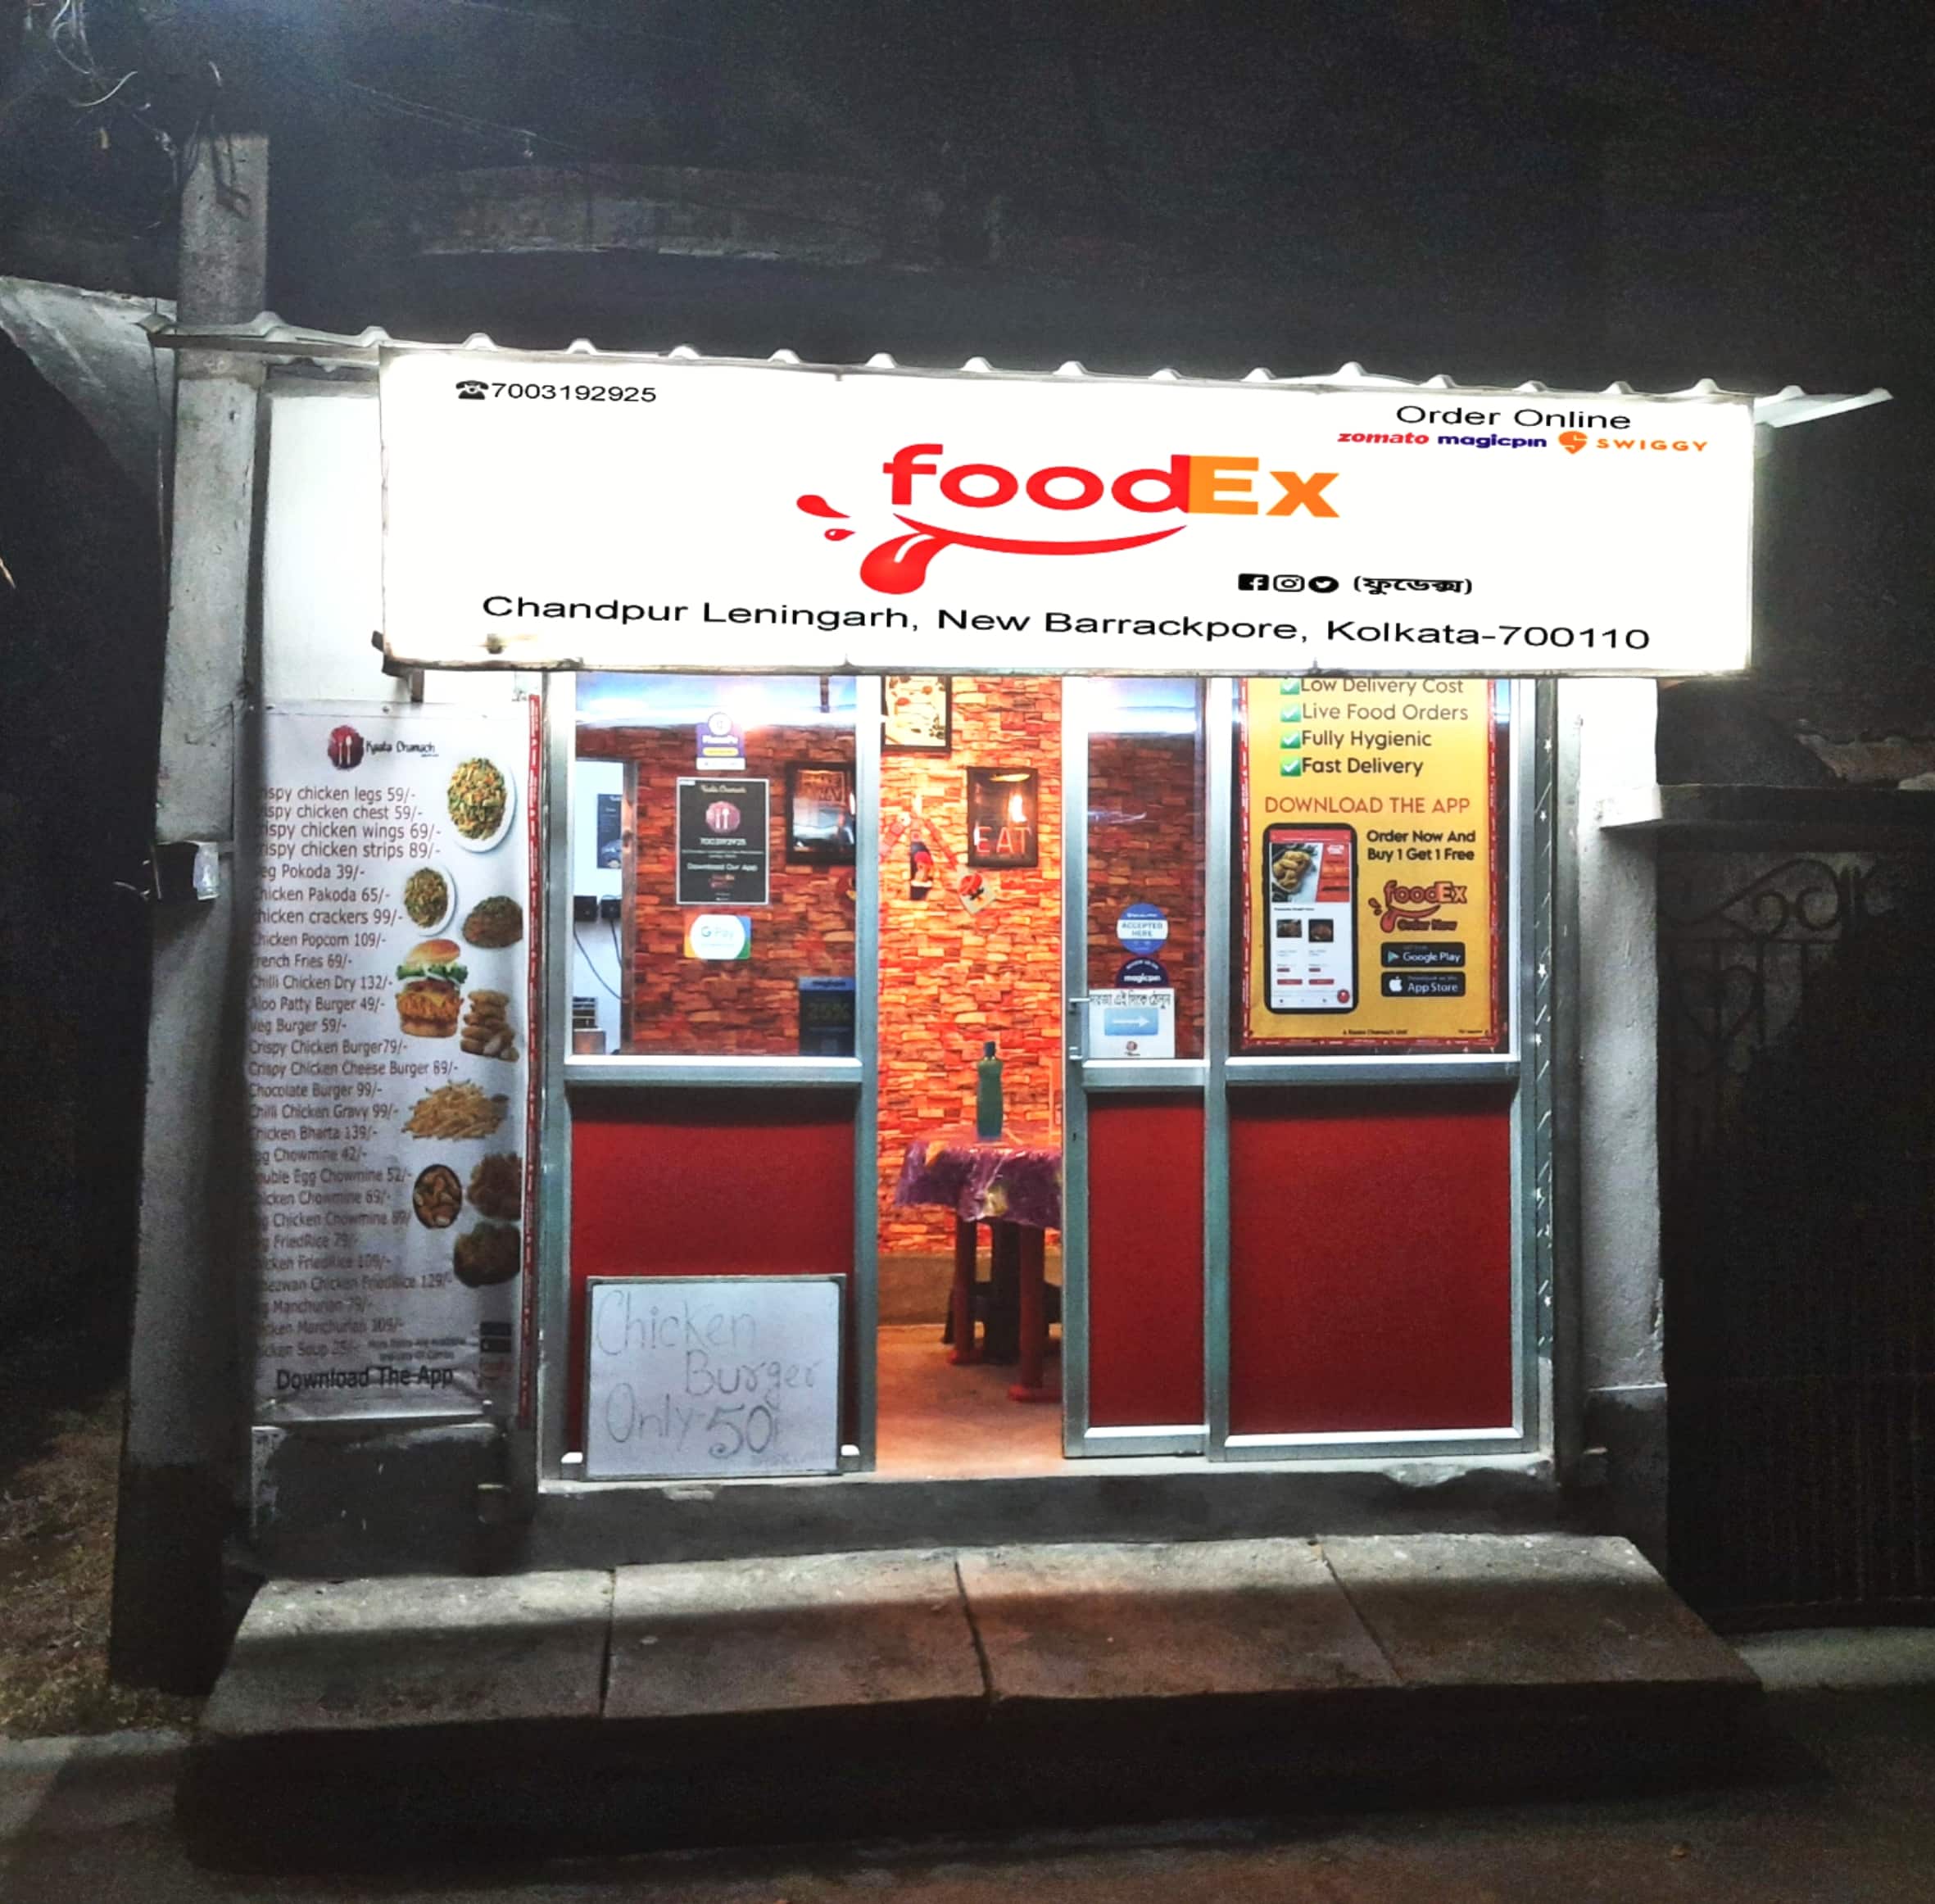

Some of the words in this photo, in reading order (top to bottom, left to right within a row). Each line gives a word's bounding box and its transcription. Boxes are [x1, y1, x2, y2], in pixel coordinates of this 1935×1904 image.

[492, 383, 656, 402] 7003192925
[1397, 406, 1501, 426] Order
[1514, 408, 1631, 429] Online
[1337, 432, 1430, 445] zomato
[1438, 433, 1548, 449] magicpin
[1596, 438, 1708, 452] SWIGGY
[882, 443, 1340, 518] foodEx
[483, 596, 689, 625] Chandpur
[704, 602, 918, 632] Leningarh,
[937, 609, 1031, 632] New
[1045, 611, 1307, 642] Barrackpore,
[1327, 620, 1650, 650] Kolkata-700110
[1301, 678, 1340, 694] Low
[1343, 678, 1415, 696] Delivery
[1422, 678, 1463, 694] Cost
[1303, 704, 1341, 719] Live
[1348, 703, 1395, 719] Food
[1403, 704, 1469, 721] Orders
[1303, 730, 1344, 750] Fully
[1350, 731, 1432, 750] Hygienic
[1303, 758, 1342, 773] Fast
[1348, 758, 1423, 779] Delivery
[297, 787, 349, 801] chicken
[354, 787, 383, 805] legs
[387, 787, 416, 804] 59/-
[297, 804, 348, 819] chicken
[353, 805, 389, 819] chest
[395, 805, 423, 823] 59/-
[1265, 797, 1383, 814] DOWNLOAD
[1389, 797, 1425, 814] THE
[1432, 797, 1471, 814] APP
[301, 822, 356, 838] chicken
[363, 823, 405, 842] wings
[410, 822, 442, 841] 69/-
[975, 826, 1031, 856] EAT
[1366, 830, 1409, 843] Order
[1412, 830, 1443, 843] Now
[1448, 830, 1475, 843] And
[301, 841, 357, 858] chicken
[363, 841, 404, 861] strips
[409, 842, 442, 860] 89/-
[1367, 849, 1394, 863] Buy
[1397, 849, 1403, 860] 1
[1406, 849, 1432, 861] Get
[1434, 849, 1441, 861] 1
[1444, 849, 1475, 861] Free
[261, 865, 276, 882] eg
[282, 863, 331, 879] Pokoda
[336, 864, 365, 882] 39/-
[309, 886, 356, 902] Pakoda
[361, 886, 391, 904] 65/-
[1383, 880, 1467, 904] foodEx
[308, 908, 369, 925] crackers
[373, 908, 403, 927] 99/-
[354, 932, 387, 950] 109/-
[255, 954, 290, 968] rench
[294, 953, 324, 968] Fries
[1402, 952, 1438, 963] Google
[1439, 952, 1461, 963] Play
[283, 975, 330, 990] Chicken
[334, 975, 356, 992] Dry
[1407, 983, 1431, 994] App
[1433, 983, 1458, 993] Store
[280, 996, 310, 1013] Patty
[315, 996, 356, 1014] Burger
[276, 1018, 317, 1036] Burger
[249, 1040, 286, 1057] Crispy
[291, 1039, 338, 1054] Chicken
[389, 1060, 429, 1078] Burger
[312, 1082, 353, 1099] Burger
[596, 1290, 757, 1356] Chicken
[276, 1367, 369, 1390] Download
[378, 1365, 410, 1386] The
[418, 1365, 453, 1390] App
[686, 1349, 820, 1408] Burger
